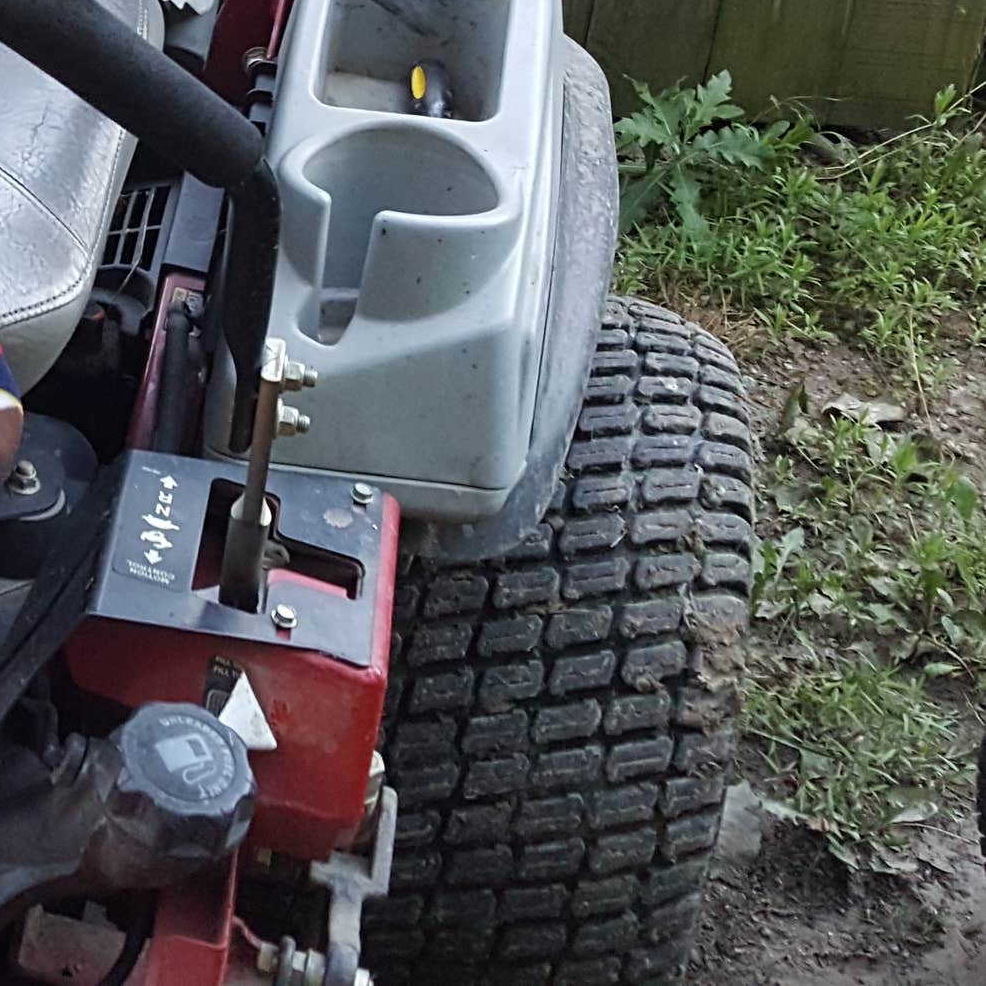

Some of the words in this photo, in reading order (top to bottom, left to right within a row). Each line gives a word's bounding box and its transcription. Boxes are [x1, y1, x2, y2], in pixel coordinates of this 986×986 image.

[155, 503, 171, 518] N
[126, 560, 175, 580] CONTROL
[129, 567, 170, 585] MOTION
